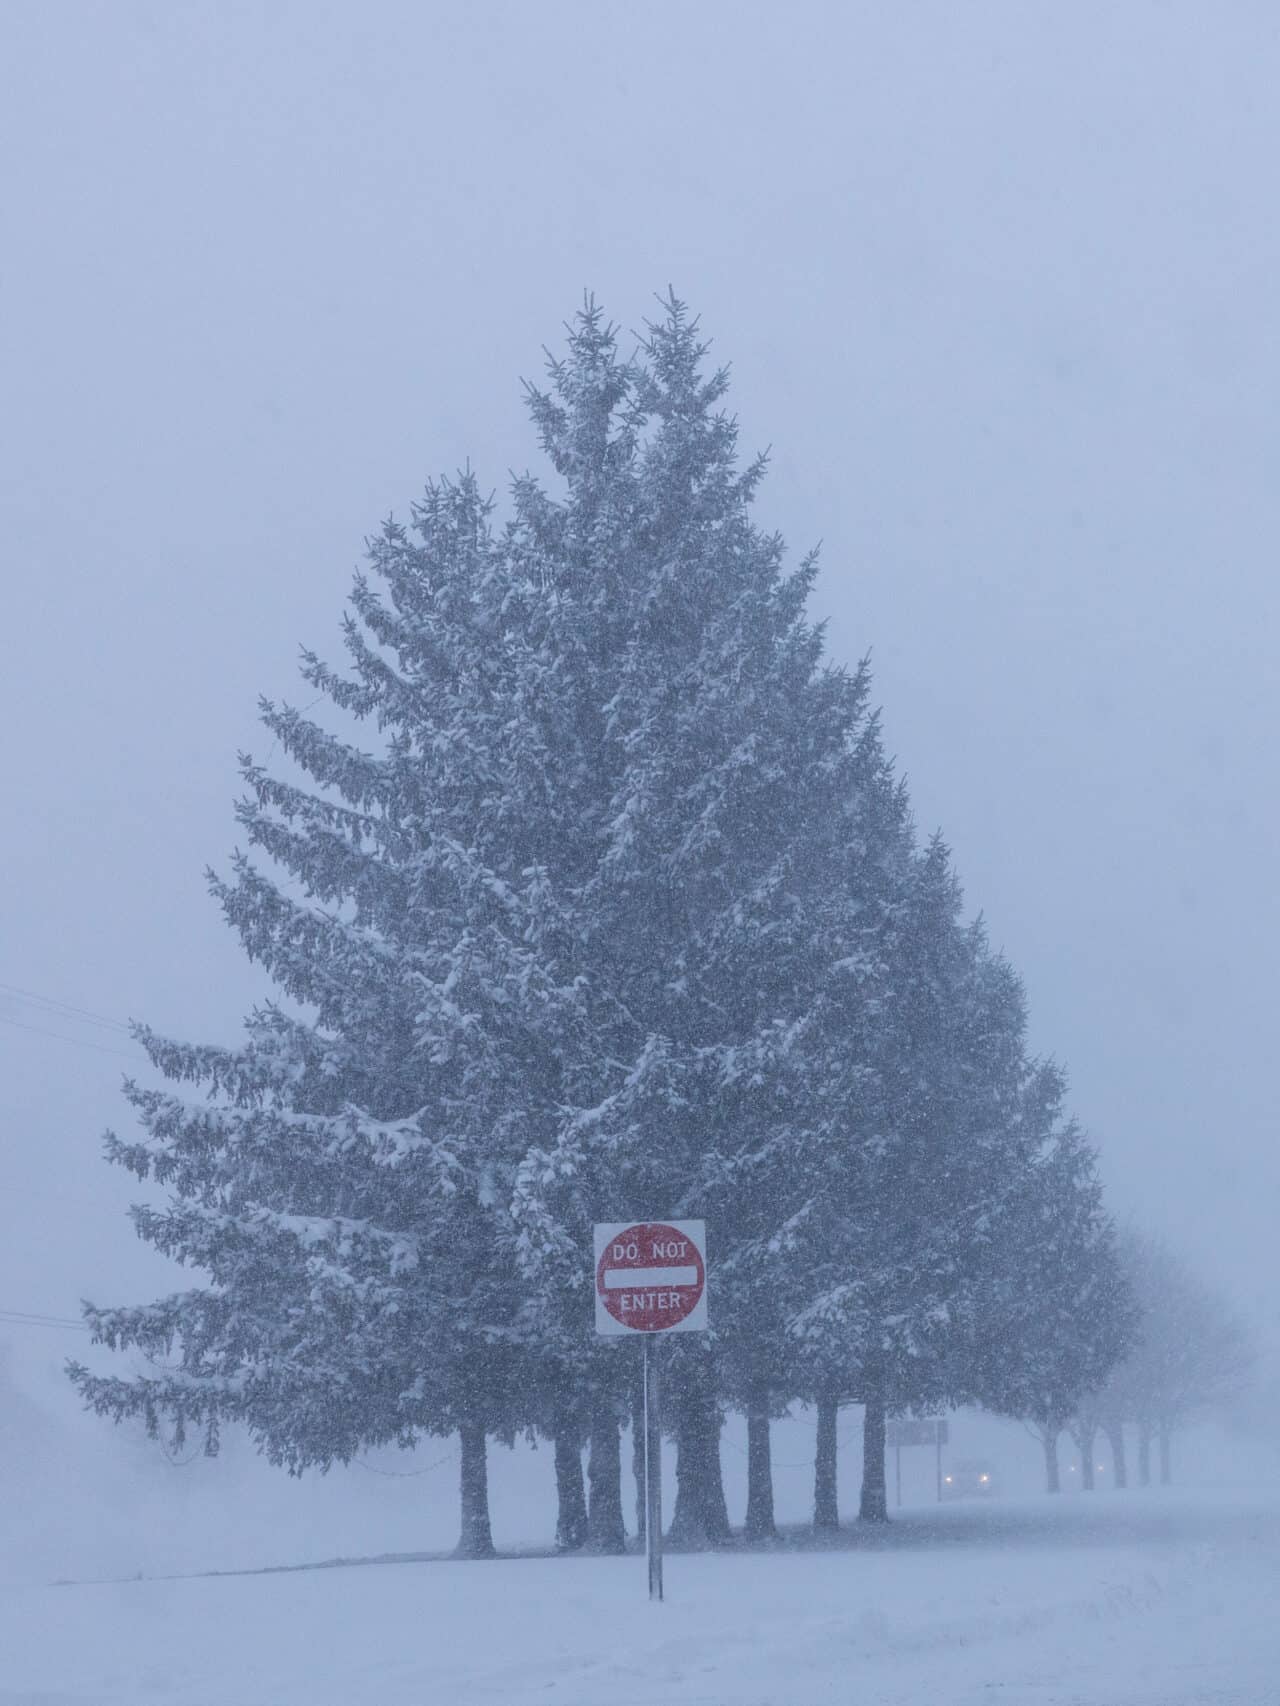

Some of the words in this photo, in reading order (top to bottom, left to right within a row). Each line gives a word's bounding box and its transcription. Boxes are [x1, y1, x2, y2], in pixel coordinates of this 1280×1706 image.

[612, 1244, 638, 1260] DO
[652, 1241, 688, 1259] NOT
[621, 1292, 681, 1311] ENTER
